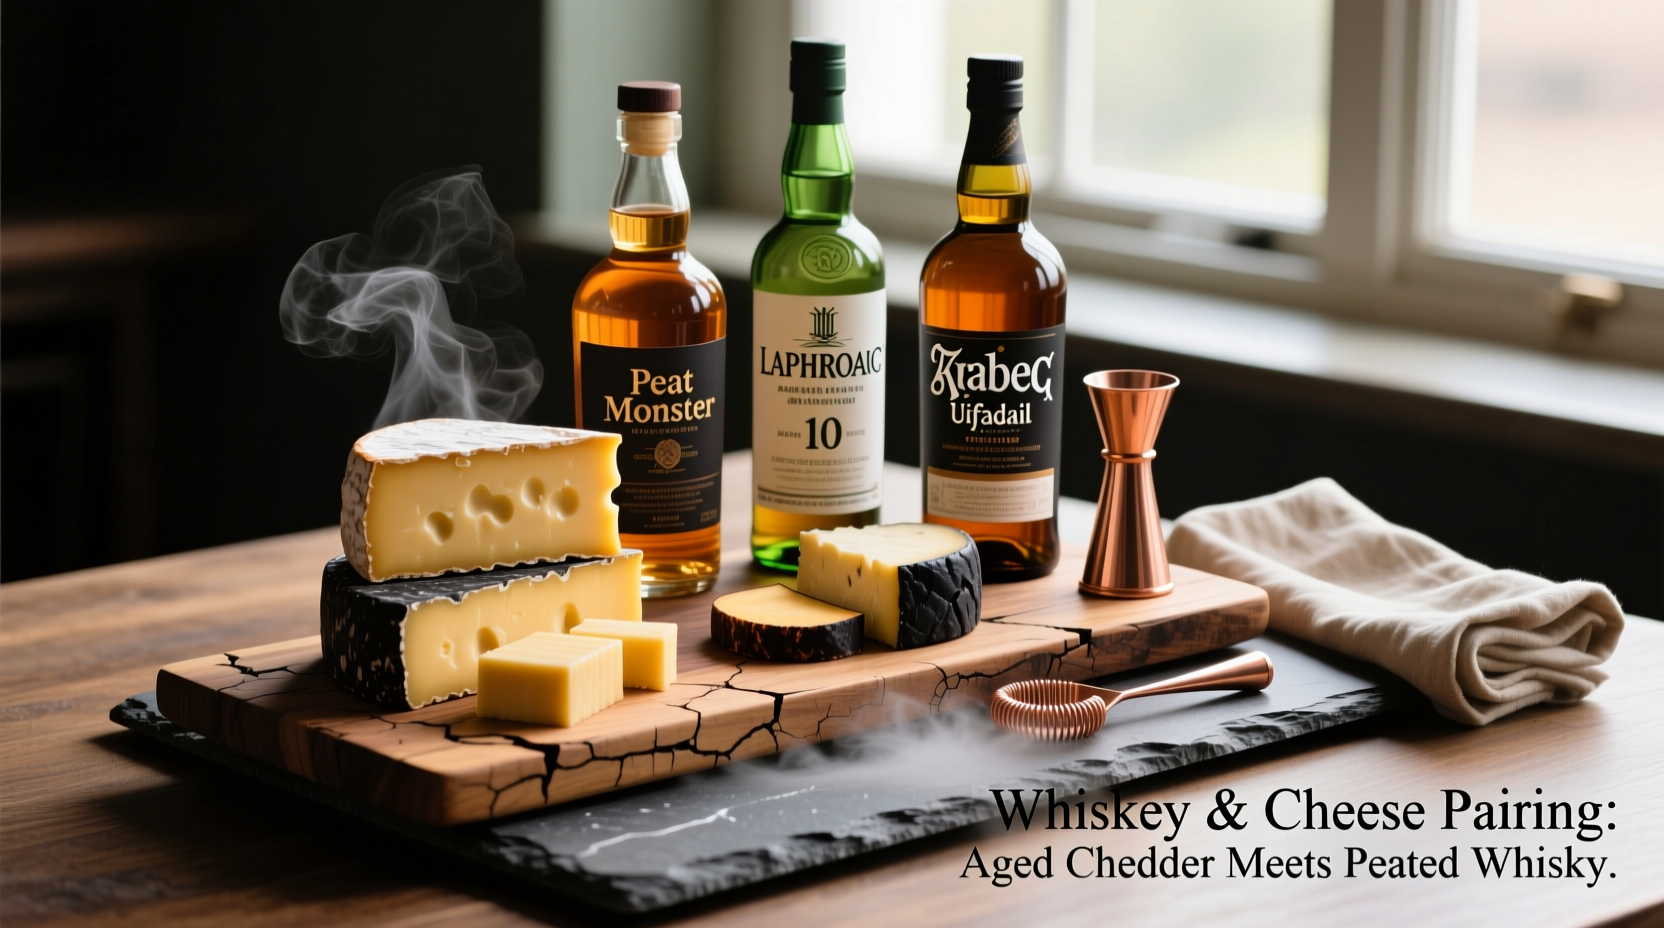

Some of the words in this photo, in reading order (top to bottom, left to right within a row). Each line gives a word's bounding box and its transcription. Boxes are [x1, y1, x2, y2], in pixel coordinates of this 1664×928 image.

[630, 369, 694, 395] Peat
[603, 396, 716, 423] Monster
[805, 417, 842, 450] 10
